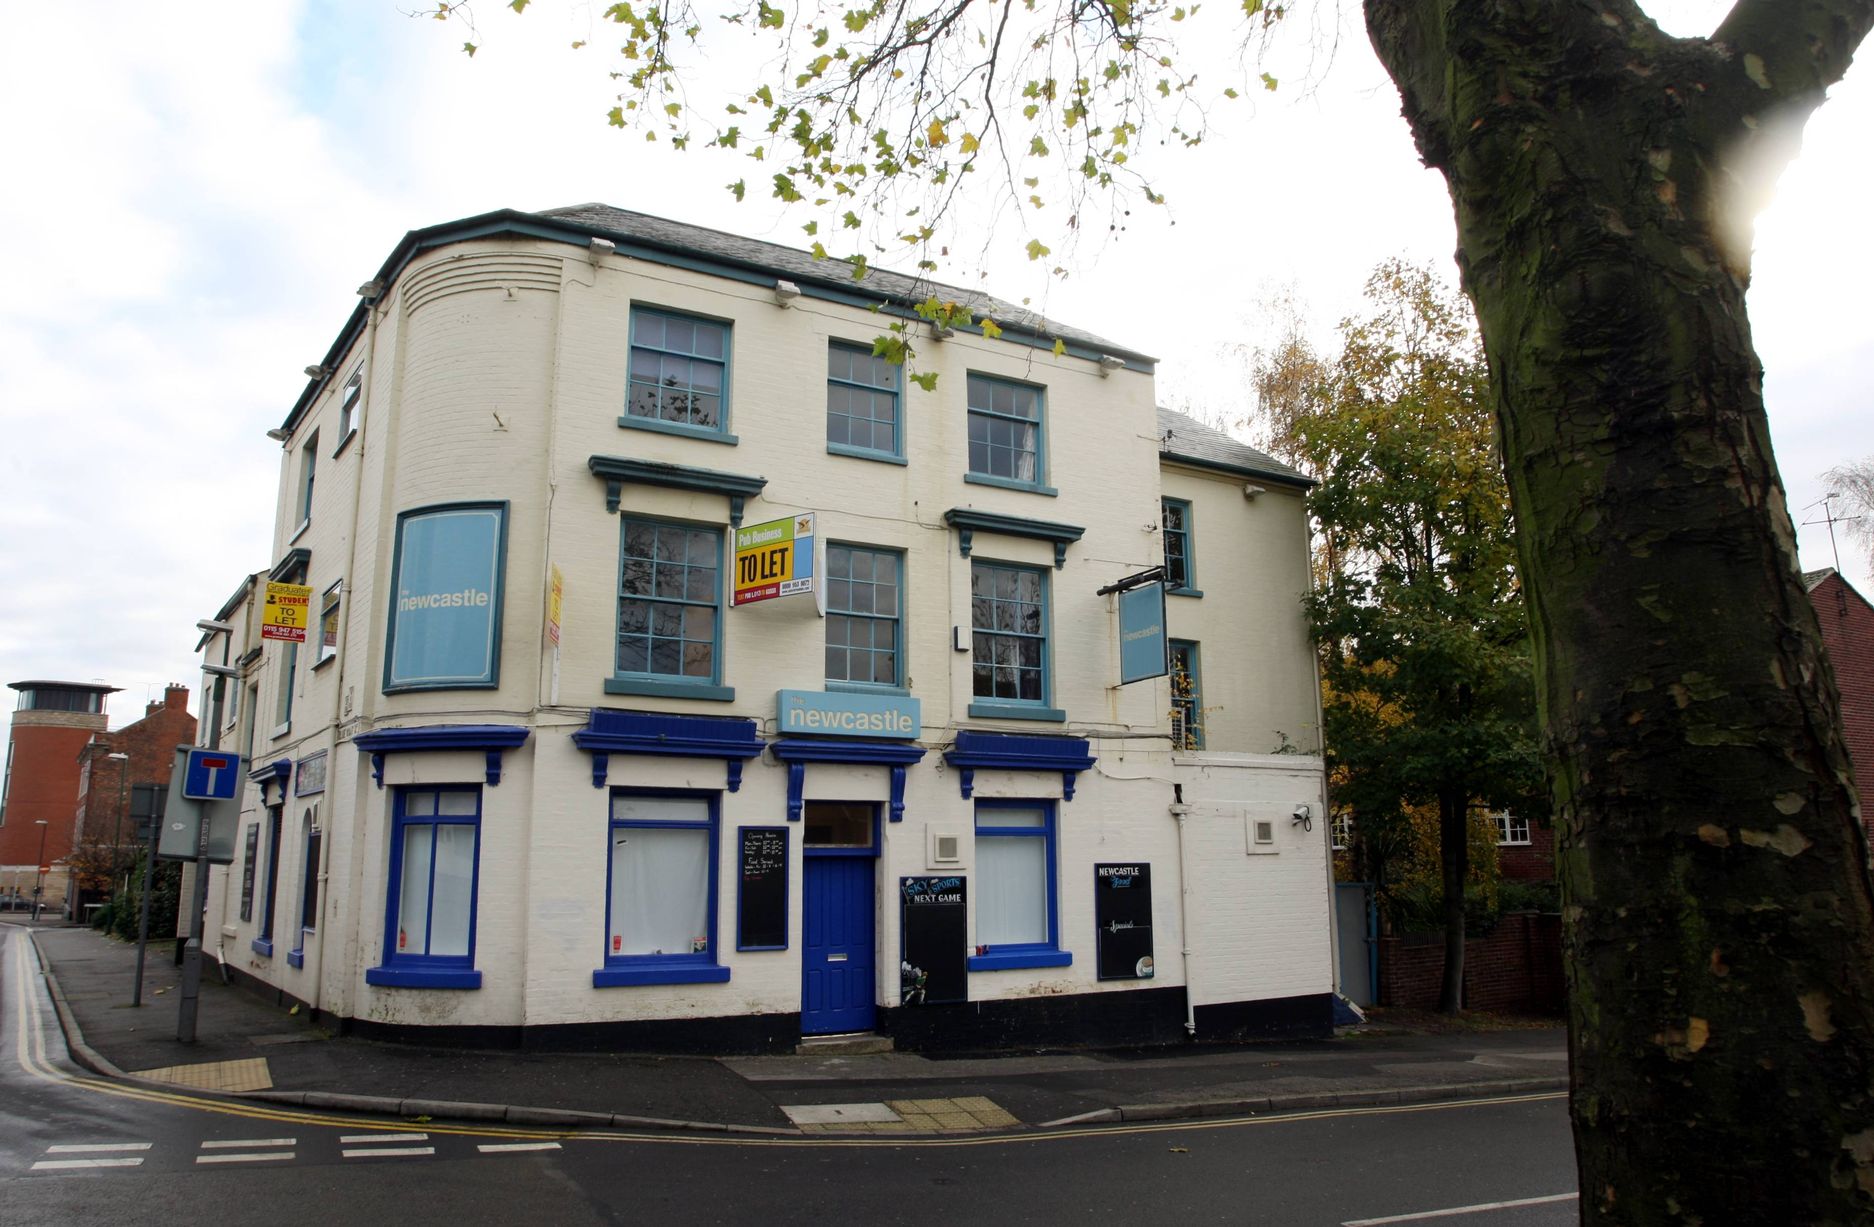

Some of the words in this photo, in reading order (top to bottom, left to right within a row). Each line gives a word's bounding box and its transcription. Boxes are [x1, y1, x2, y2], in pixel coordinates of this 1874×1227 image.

[739, 532, 752, 547] Pub
[752, 528, 782, 543] Business
[739, 554, 758, 584] TO
[760, 547, 789, 579] LET
[400, 588, 488, 612] newcastle
[275, 616, 297, 625] LET
[280, 607, 295, 616] TO
[789, 707, 914, 733] newcastle
[1099, 866, 1140, 877] NEWCASTLE
[907, 880, 928, 895] SKY
[931, 877, 961, 893] SPORTS
[914, 894, 937, 903] NEXT
[937, 893, 962, 903] GAME
